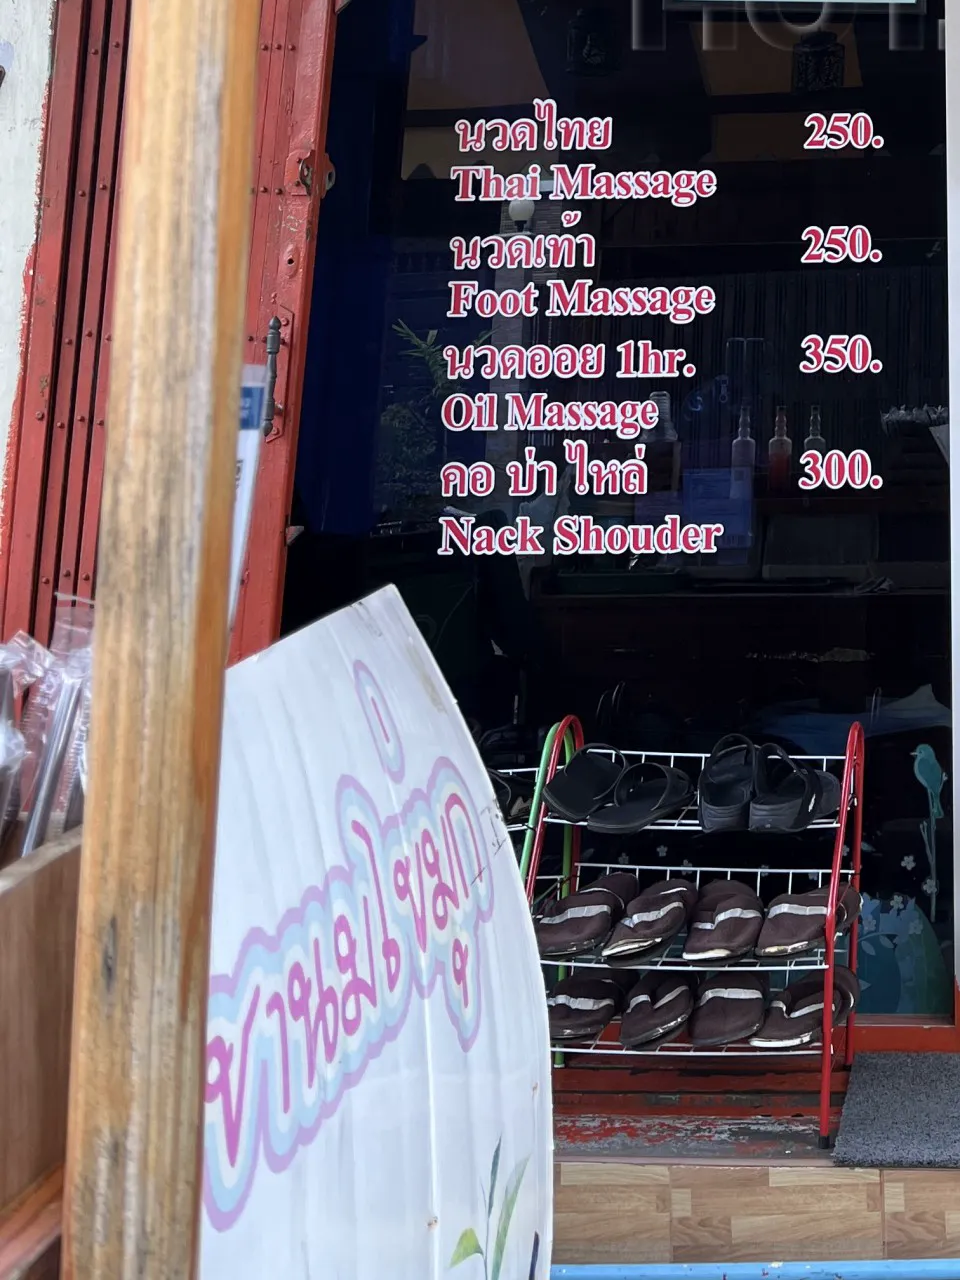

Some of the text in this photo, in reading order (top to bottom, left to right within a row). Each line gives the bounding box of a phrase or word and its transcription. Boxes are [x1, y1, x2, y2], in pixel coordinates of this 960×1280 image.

[455, 98, 613, 152] นวดไทย
[803, 112, 885, 150] 250.
[450, 164, 717, 207] Thai Massage
[450, 210, 595, 269] นวดเท้า
[801, 225, 882, 263] 250.
[447, 278, 715, 325] Foot Massage
[443, 340, 697, 380] นวดออย 1hr.
[800, 334, 882, 373] 350.
[441, 393, 659, 439] Oil Massage
[441, 461, 496, 497] คอ
[563, 437, 648, 496] ไหล่
[799, 449, 882, 489] 300.
[438, 514, 724, 556] Nack Shouder
